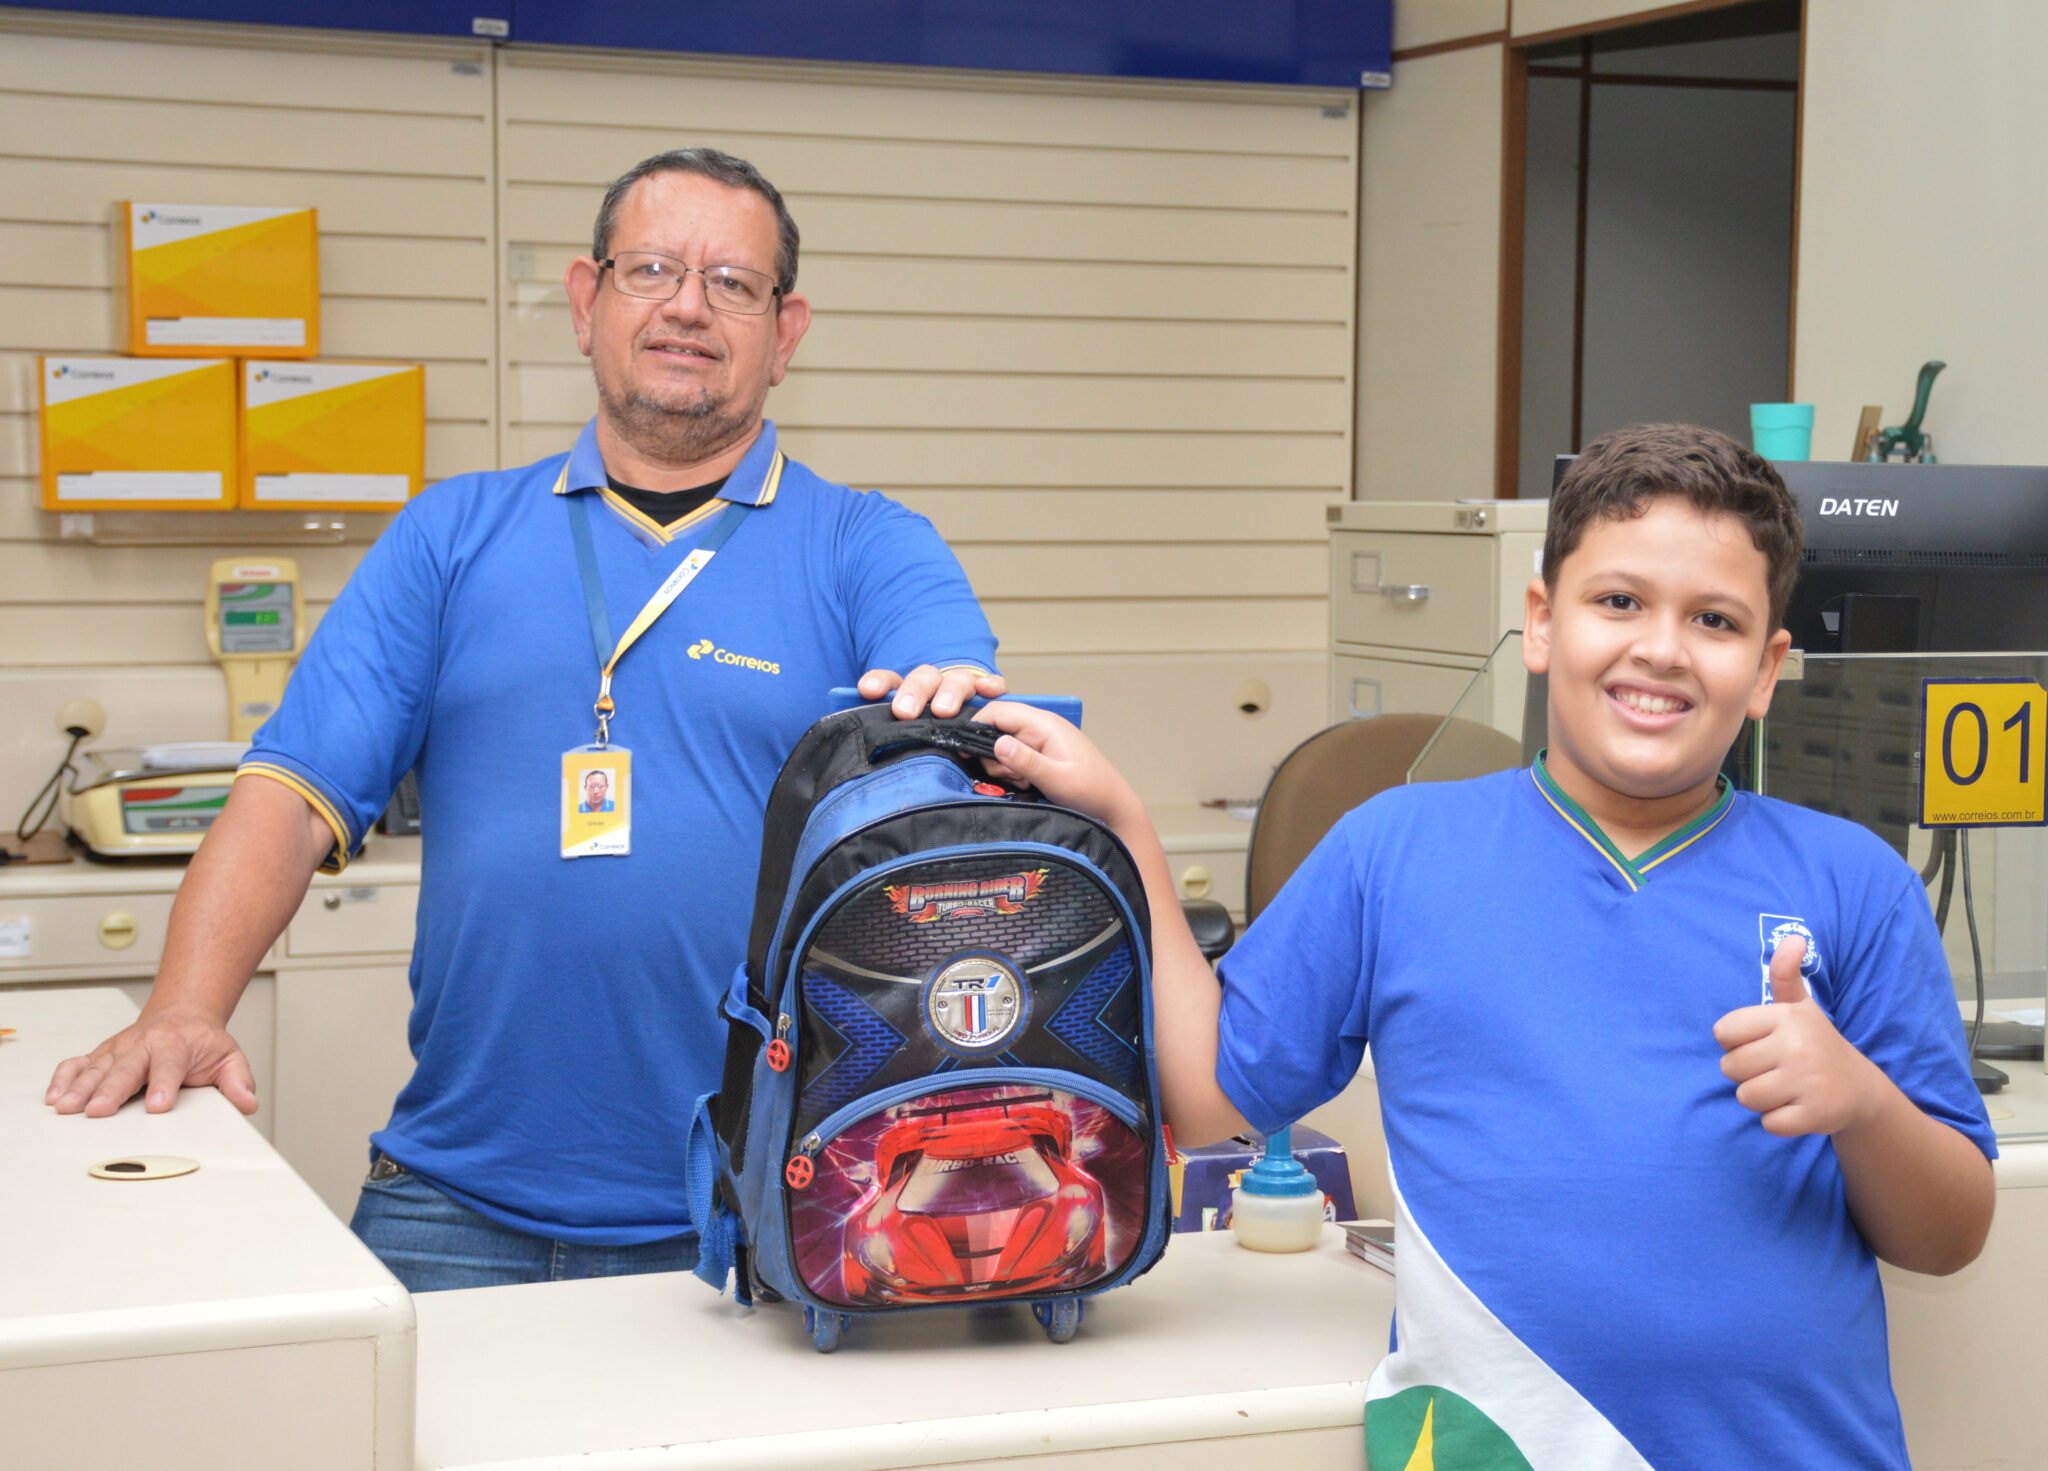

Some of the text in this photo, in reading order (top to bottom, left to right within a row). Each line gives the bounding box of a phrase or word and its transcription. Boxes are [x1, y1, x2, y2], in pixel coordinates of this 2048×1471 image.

[1819, 498, 1899, 516] DATEN
[714, 648, 780, 675] Correios
[1942, 701, 2031, 786] 01
[1932, 809, 2036, 822] www.correios.com.br
